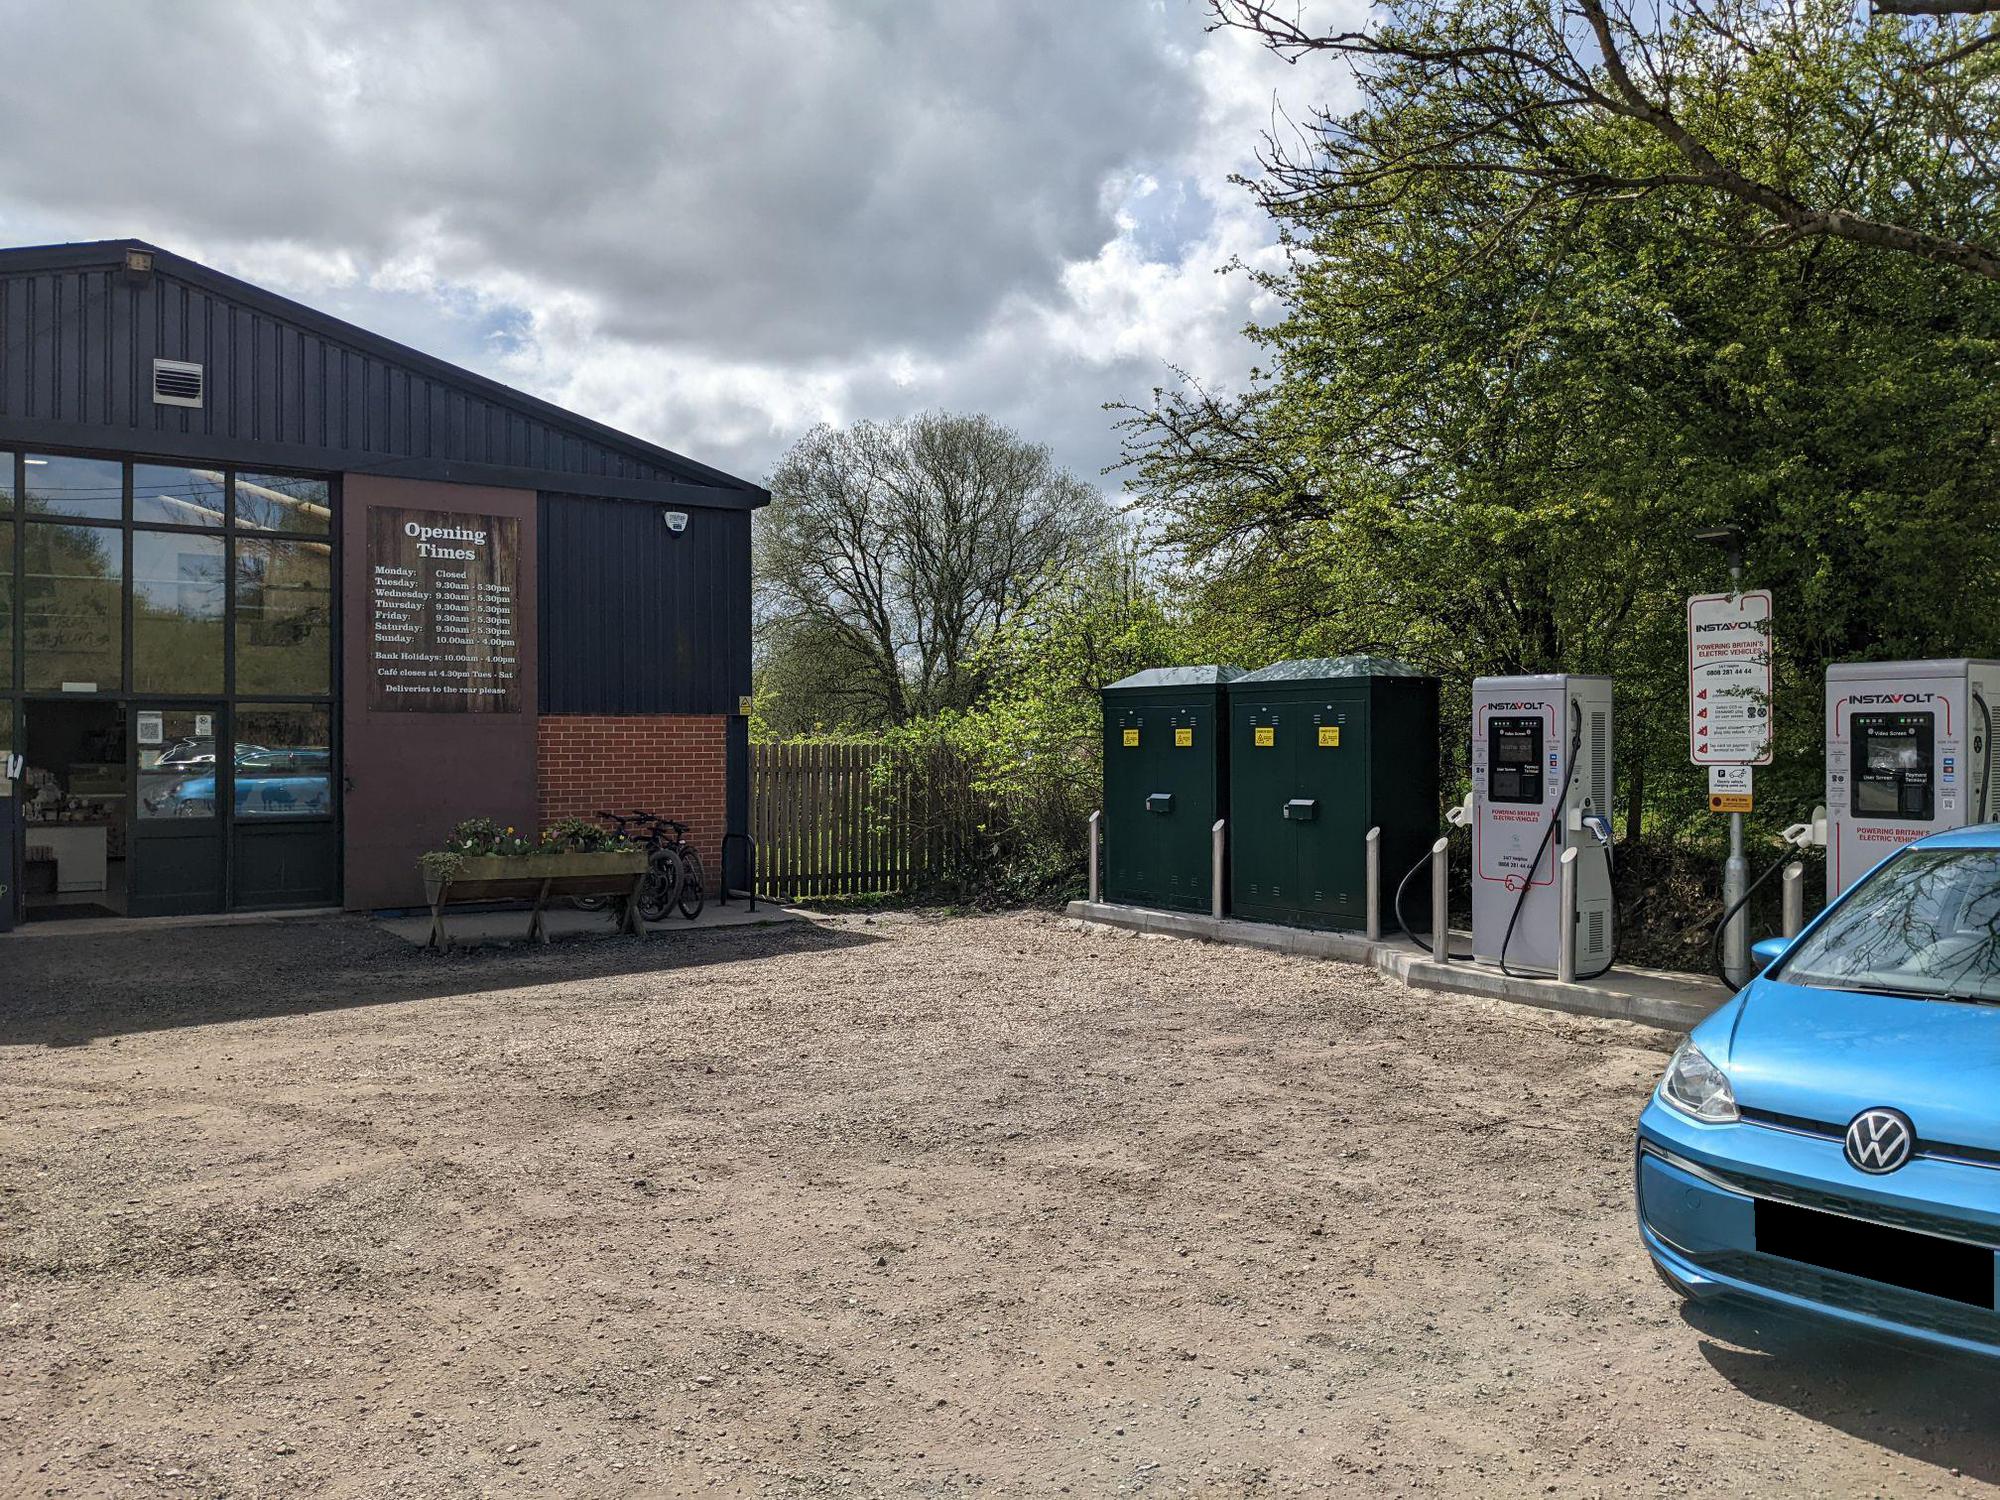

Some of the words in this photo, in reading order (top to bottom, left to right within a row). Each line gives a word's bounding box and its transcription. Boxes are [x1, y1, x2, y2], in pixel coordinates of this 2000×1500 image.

[404, 522, 487, 545] Opening
[416, 543, 476, 561] Times
[375, 566, 417, 577] Monday:
[436, 570, 467, 579] Closed
[375, 577, 418, 588] Tuesday:
[436, 581, 469, 590] 9.30am
[477, 584, 511, 592] 5.30pm
[375, 588, 432, 599] Wednesday:
[436, 593, 469, 601] 9.30am
[477, 595, 511, 603] 5.30pm
[375, 599, 425, 610] Thursday:
[436, 603, 469, 612] 9.30am
[477, 606, 511, 614] 5.30pm
[375, 611, 411, 622] Friday:
[436, 614, 469, 623] 9.30am
[477, 617, 511, 625] 5.30pm
[375, 622, 423, 633] Saturday:
[436, 625, 469, 634] 9.30am
[477, 628, 511, 636] 5.30pm
[375, 634, 414, 643] Sunday:
[436, 636, 474, 645] 10.00am
[482, 638, 515, 647] 4.00pm
[401, 653, 441, 662] Holidays:
[444, 654, 478, 662] 10.00am
[486, 655, 515, 664] 4.00pm
[378, 668, 397, 676] Café
[440, 670, 470, 679] 4.30pm
[386, 685, 430, 693] Deliveries
[479, 686, 506, 695] please
[1848, 693, 1934, 704] INSTAVOLT
[1488, 702, 1544, 710] INSTAVOLT
[1857, 827, 1893, 835] POWERING
